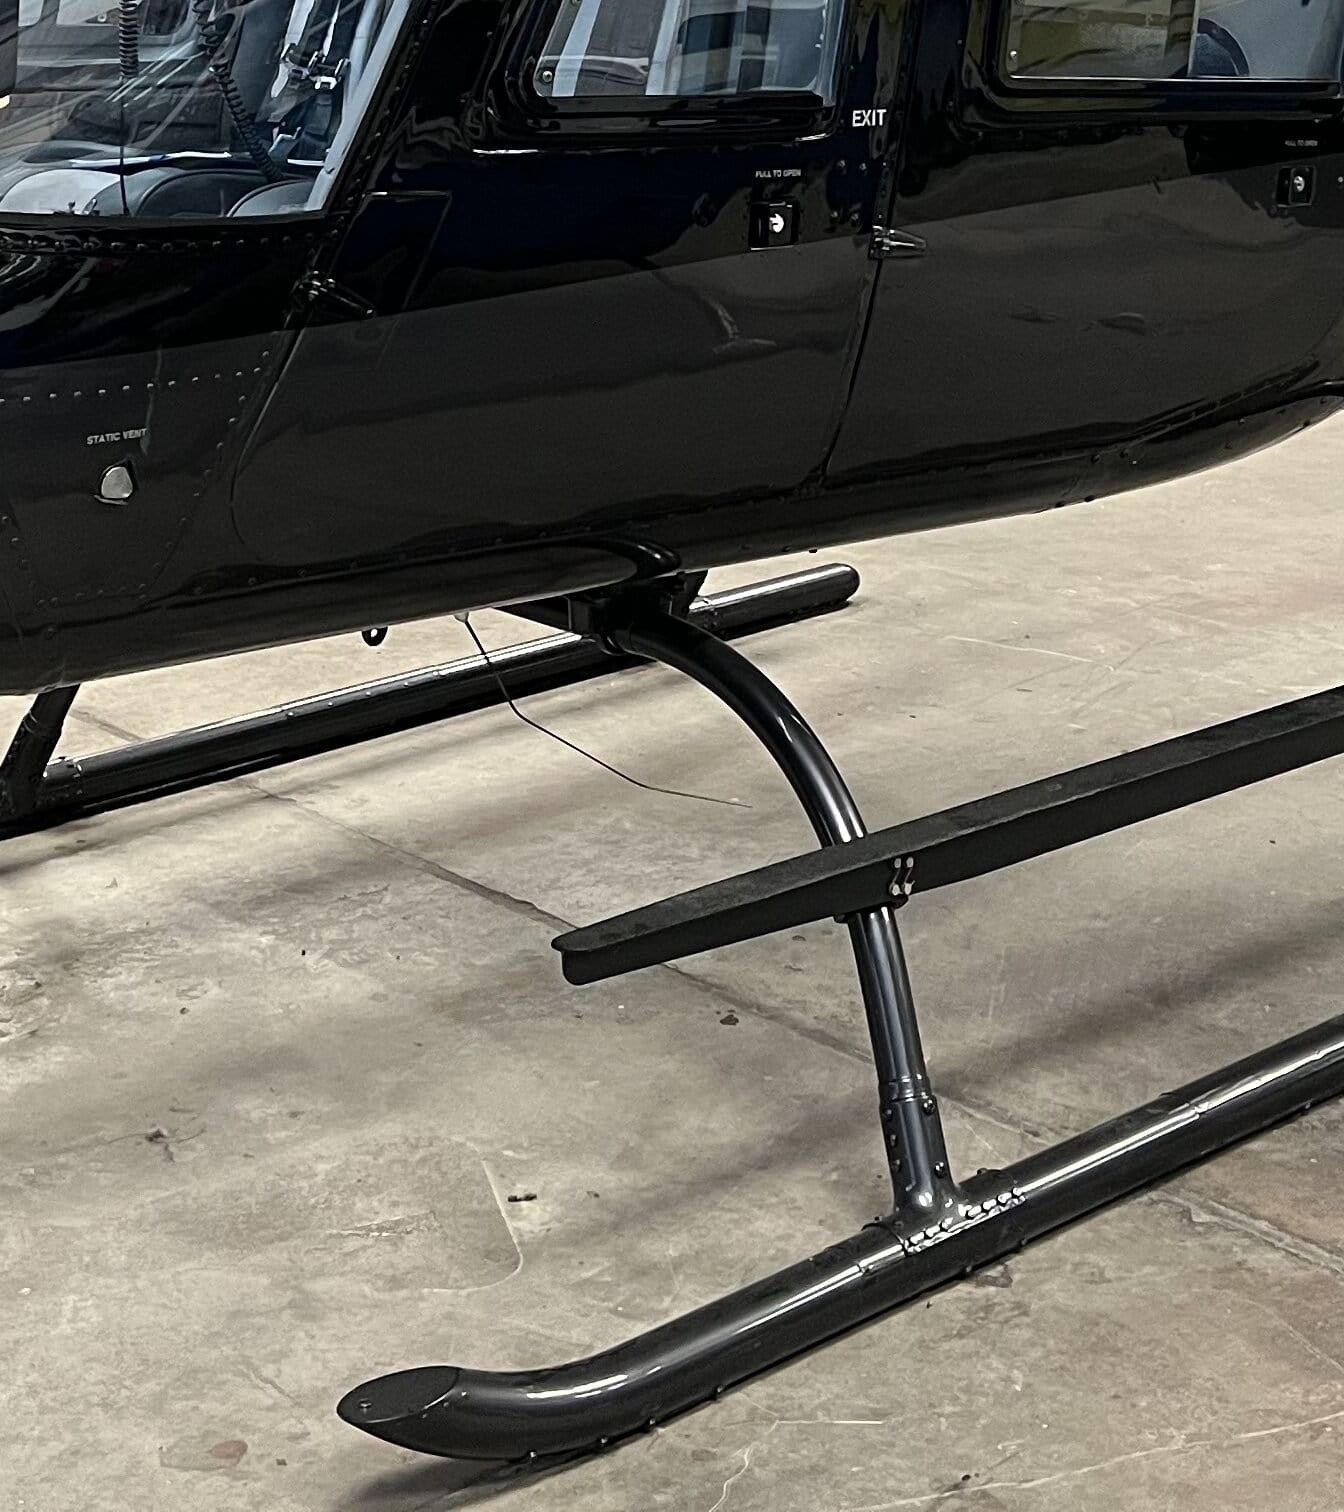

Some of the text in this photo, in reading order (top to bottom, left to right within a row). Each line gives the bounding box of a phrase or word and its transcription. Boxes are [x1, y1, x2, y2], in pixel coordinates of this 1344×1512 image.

[852, 109, 887, 127] EXIT
[86, 428, 148, 445] STATIC VENT
